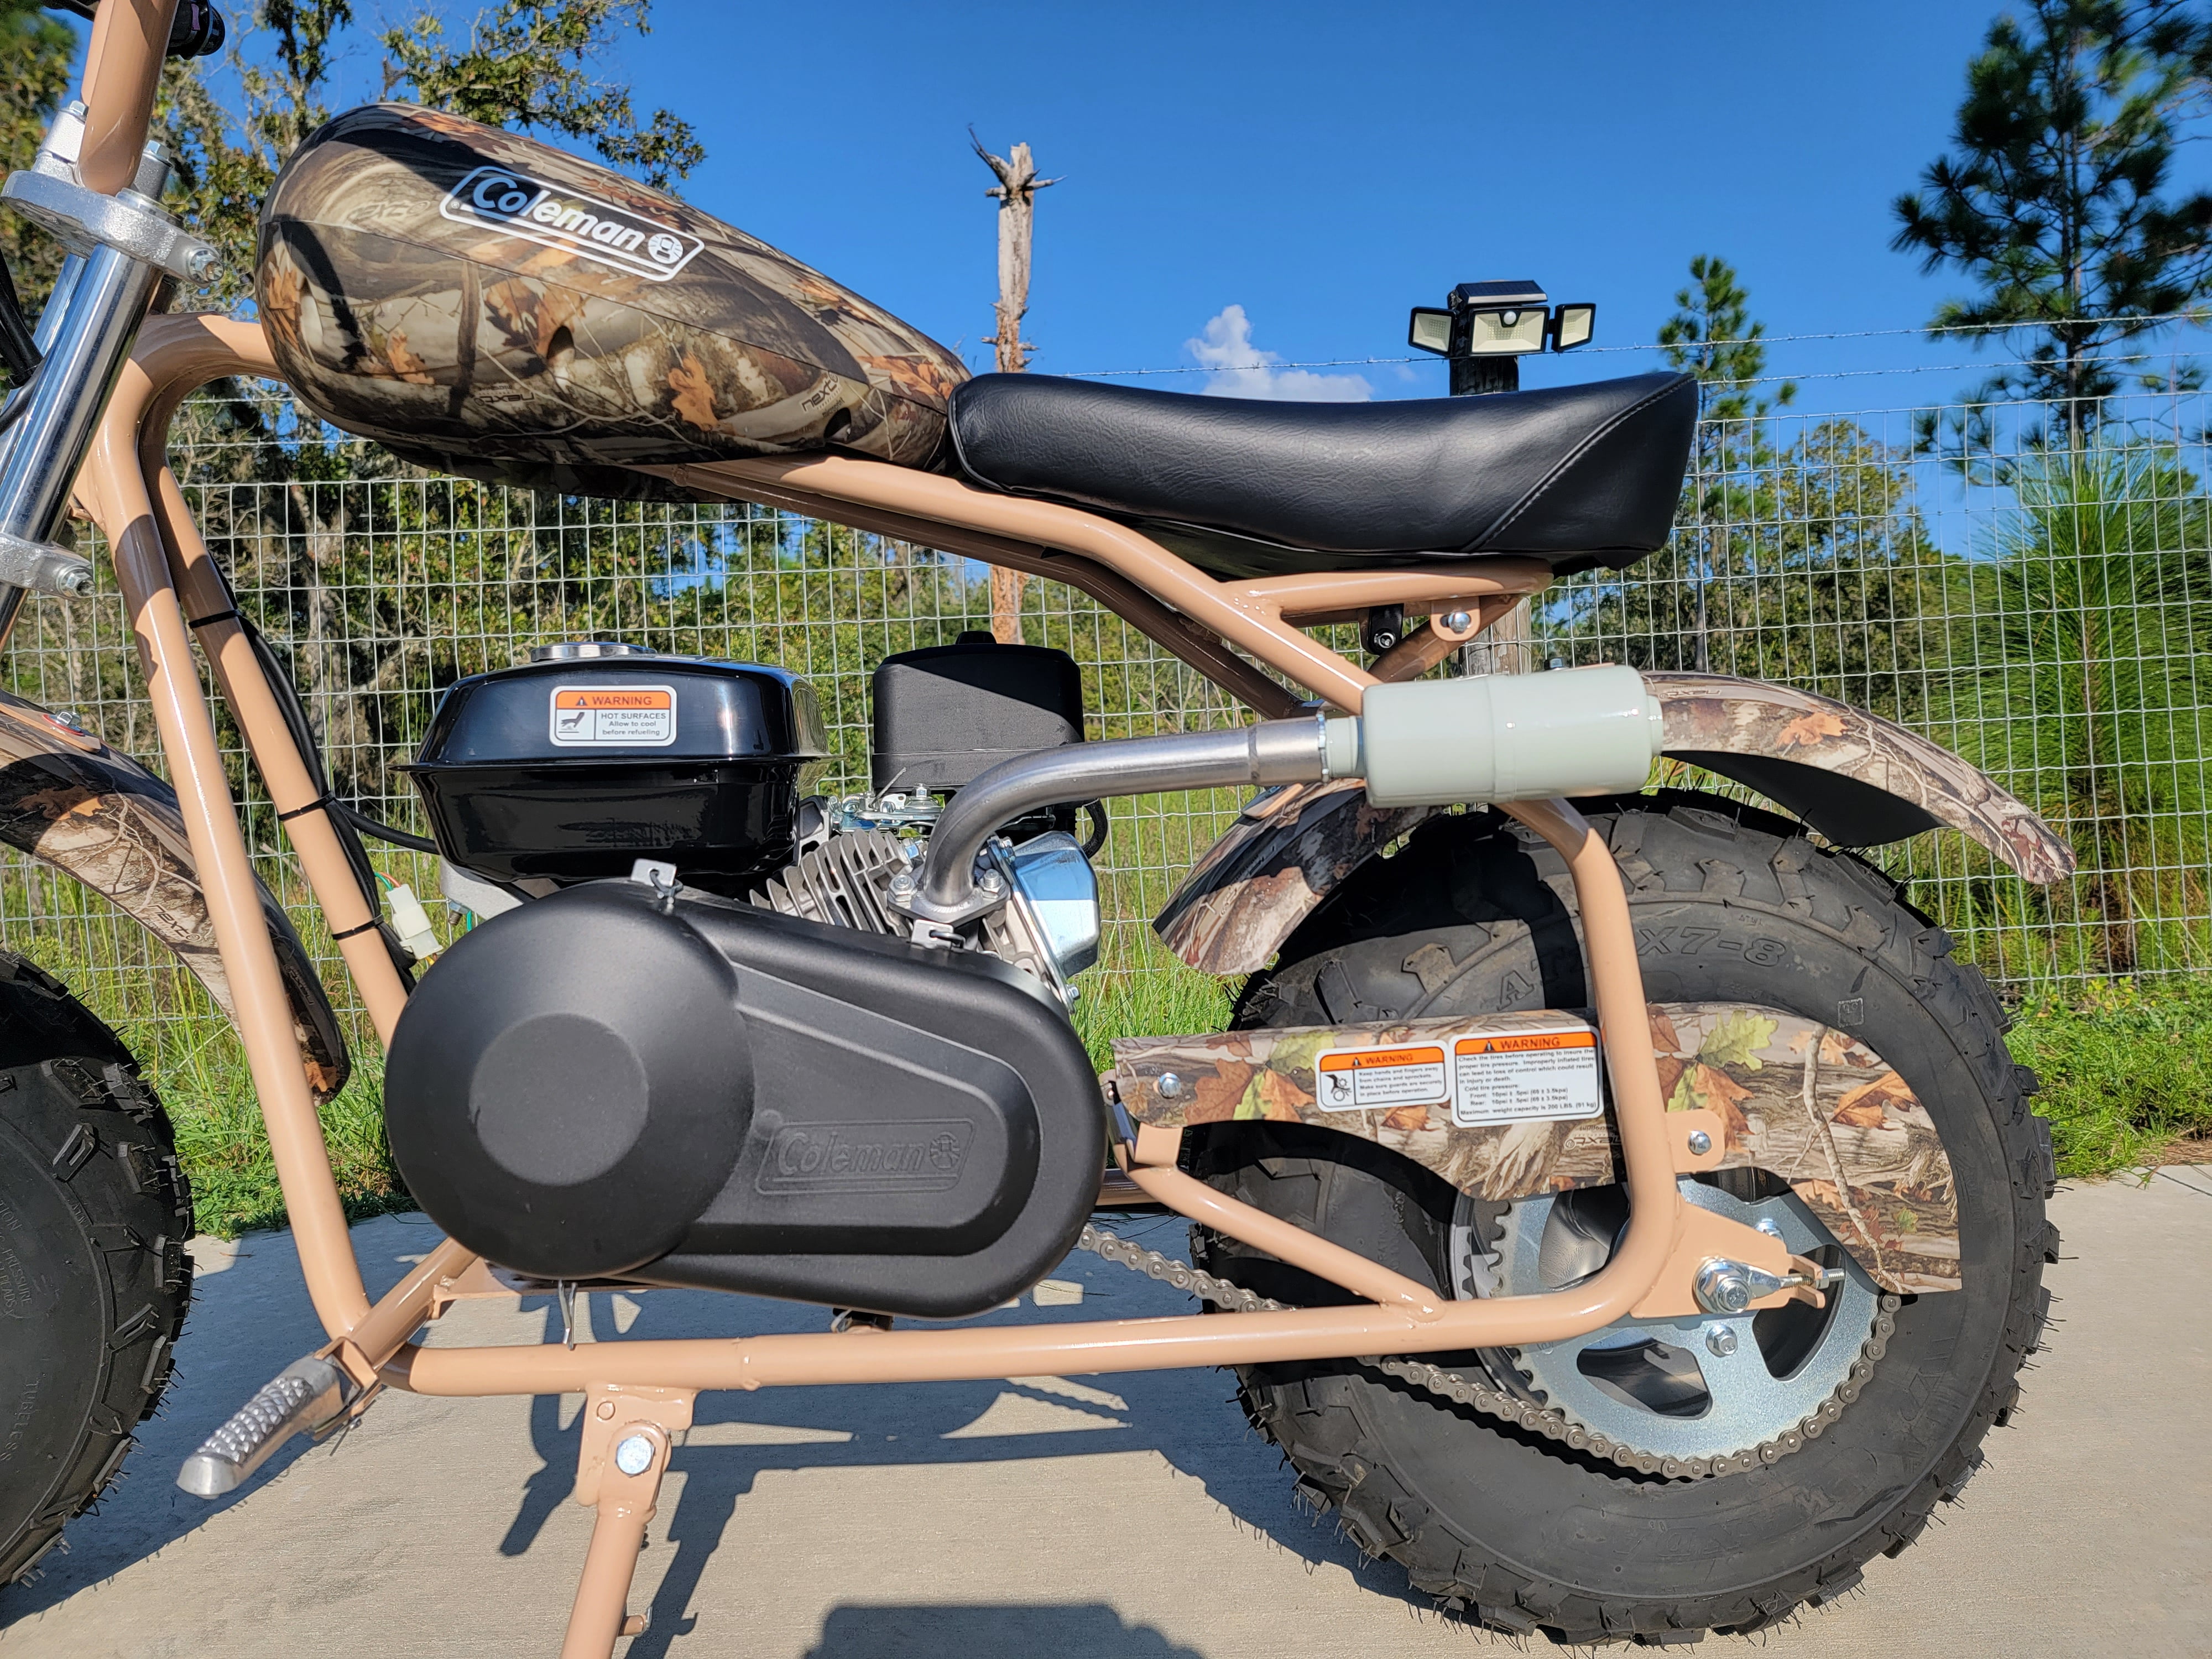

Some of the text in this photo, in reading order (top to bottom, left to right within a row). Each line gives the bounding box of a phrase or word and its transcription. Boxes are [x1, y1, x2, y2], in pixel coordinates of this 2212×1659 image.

[473, 176, 646, 252] Coleman
[479, 392, 535, 404] next
[802, 379, 837, 412] next
[592, 696, 652, 705] WARNING
[145, 905, 190, 937] next
[1500, 1037, 1560, 1050] WARNING
[1365, 1053, 1413, 1065] WARNING
[778, 1132, 926, 1176] Coleman
